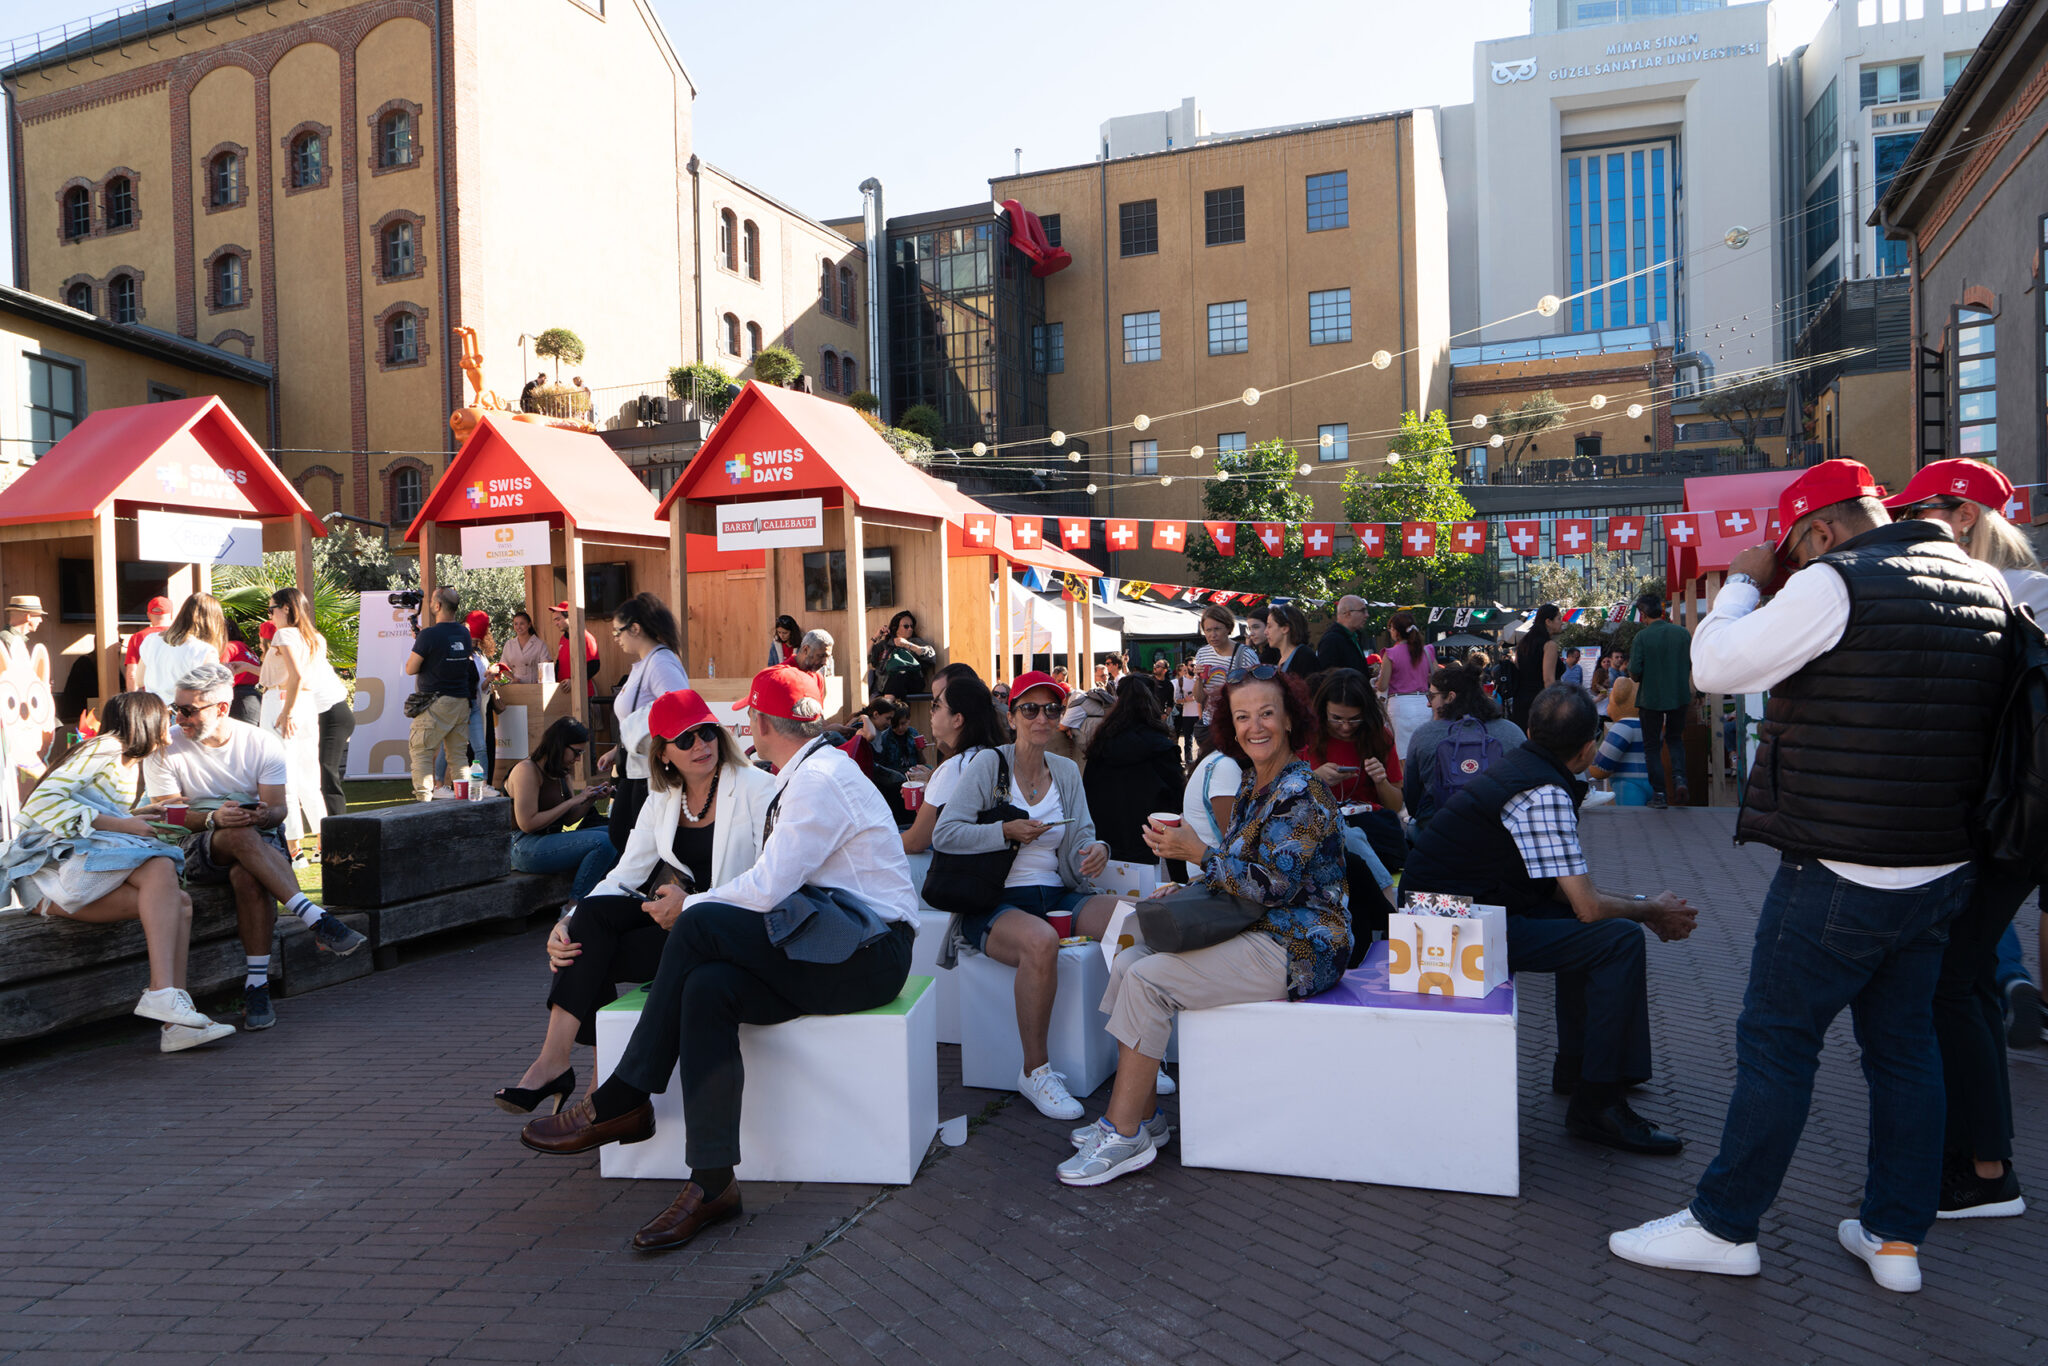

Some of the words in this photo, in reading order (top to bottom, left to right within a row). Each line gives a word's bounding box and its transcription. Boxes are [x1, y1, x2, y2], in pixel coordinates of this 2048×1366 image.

[1606, 39, 1651, 56] MİMAR
[1655, 32, 1699, 49] SİNAN
[1549, 65, 1592, 81] GÜZEL
[1594, 56, 1662, 76] SANATLAR
[753, 448, 804, 466] SWISS
[189, 463, 248, 484] SWISS
[754, 467, 794, 483] DAYS
[190, 483, 237, 500] DAYS
[489, 477, 532, 492] SWISS
[490, 493, 523, 508] DAYS
[724, 522, 752, 532] BARRY
[763, 518, 815, 530] CALLEBAUT
